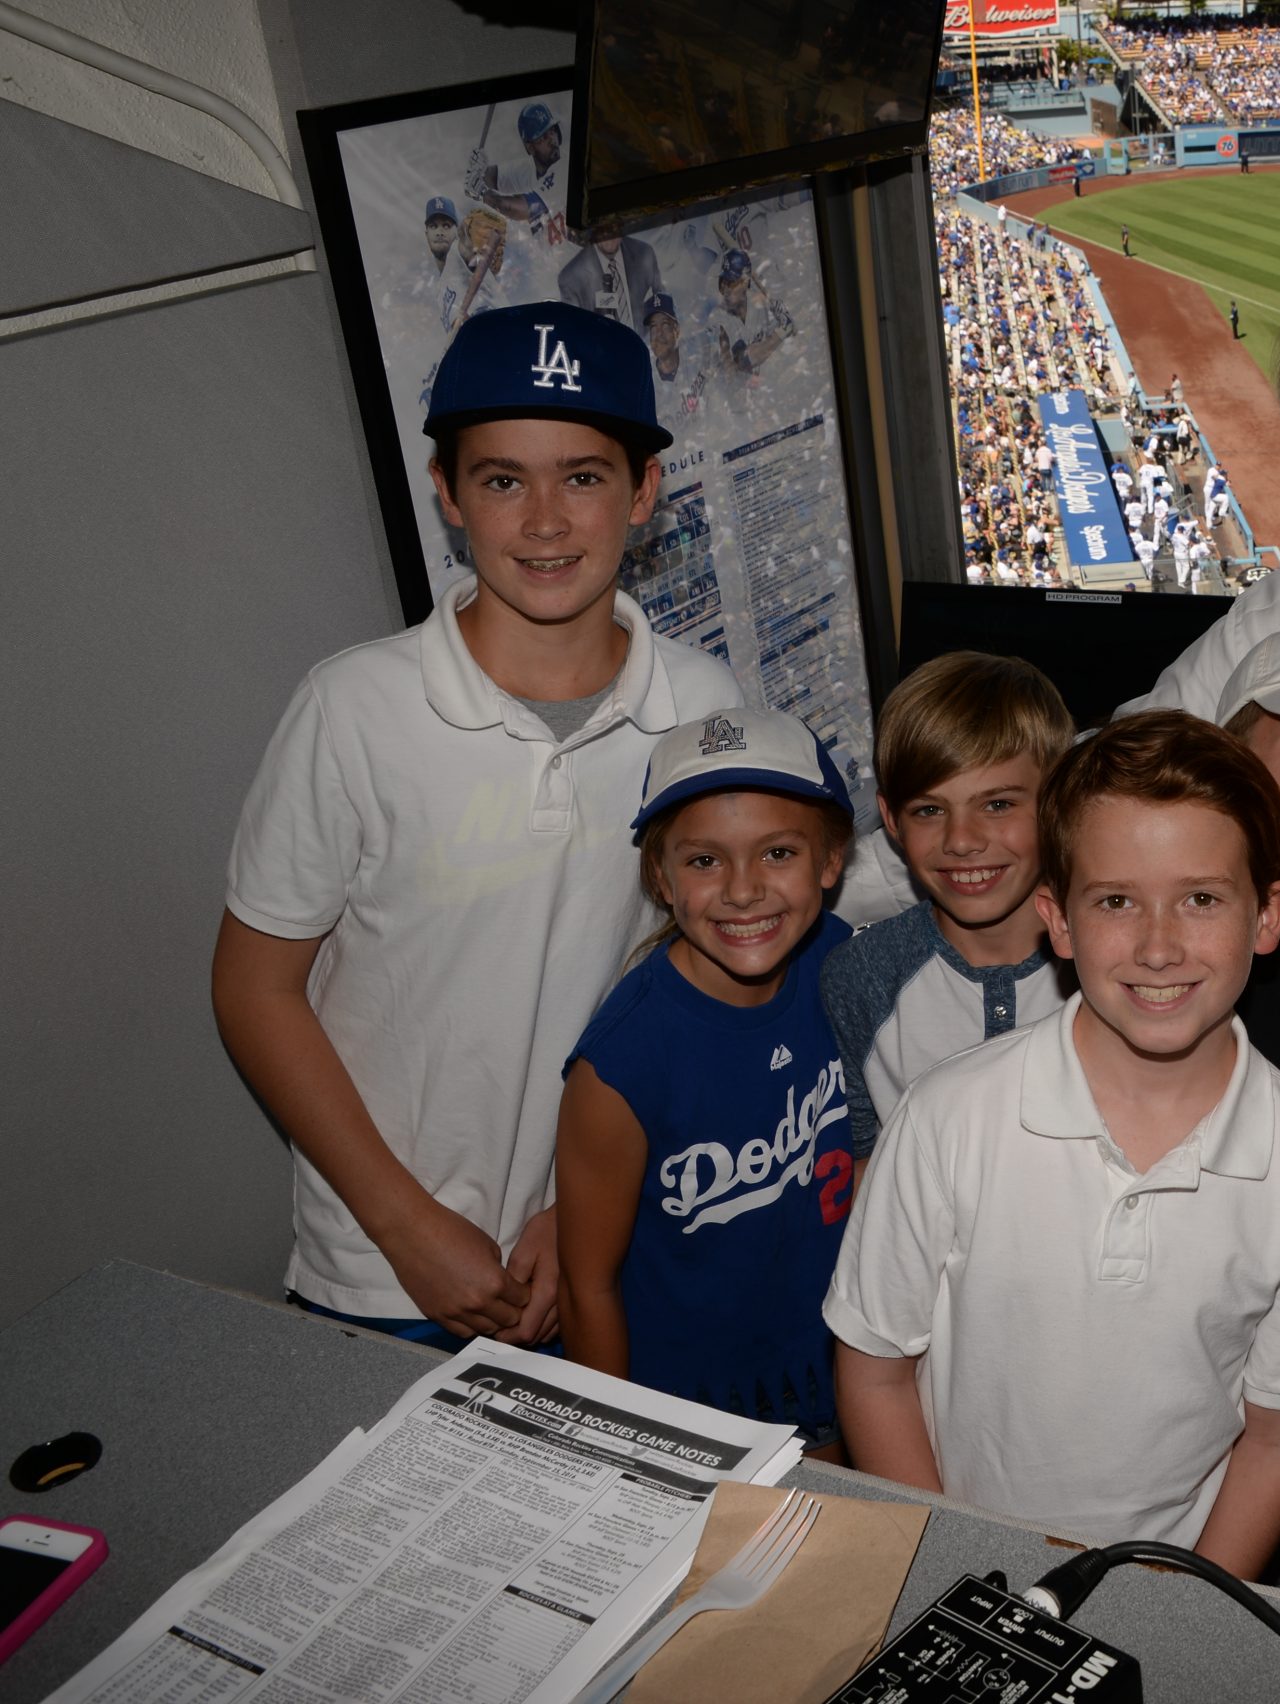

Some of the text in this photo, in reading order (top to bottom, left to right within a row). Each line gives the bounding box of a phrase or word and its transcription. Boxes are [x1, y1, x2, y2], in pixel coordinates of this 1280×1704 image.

[944, 4, 1055, 27] Bweiser
[1221, 141, 1234, 152] 76
[531, 323, 582, 392] LA
[662, 450, 705, 478] EDULE
[1079, 524, 1108, 561] Spectrum
[444, 550, 466, 569] 20
[1046, 592, 1121, 602] HD PROGRAM
[699, 715, 746, 755] LA
[661, 1058, 849, 1234] Dodger
[431, 1402, 465, 1419] COLORADO
[464, 1416, 490, 1430] ROCKIES
[514, 1435, 526, 1444] LOS
[526, 1440, 554, 1455] ANGELES
[553, 1449, 583, 1465] DODGERS
[509, 1387, 582, 1421] COLORADO
[579, 1413, 638, 1439] ROCKIES
[635, 1432, 676, 1452] GAME
[674, 1444, 723, 1467] NOTES
[635, 1477, 664, 1491] PROBABLE
[970, 1595, 994, 1610] INPUT
[1012, 1606, 1034, 1621] LOOP
[998, 1617, 1026, 1635] DRIVER
[1034, 1627, 1066, 1647] OUTPUT
